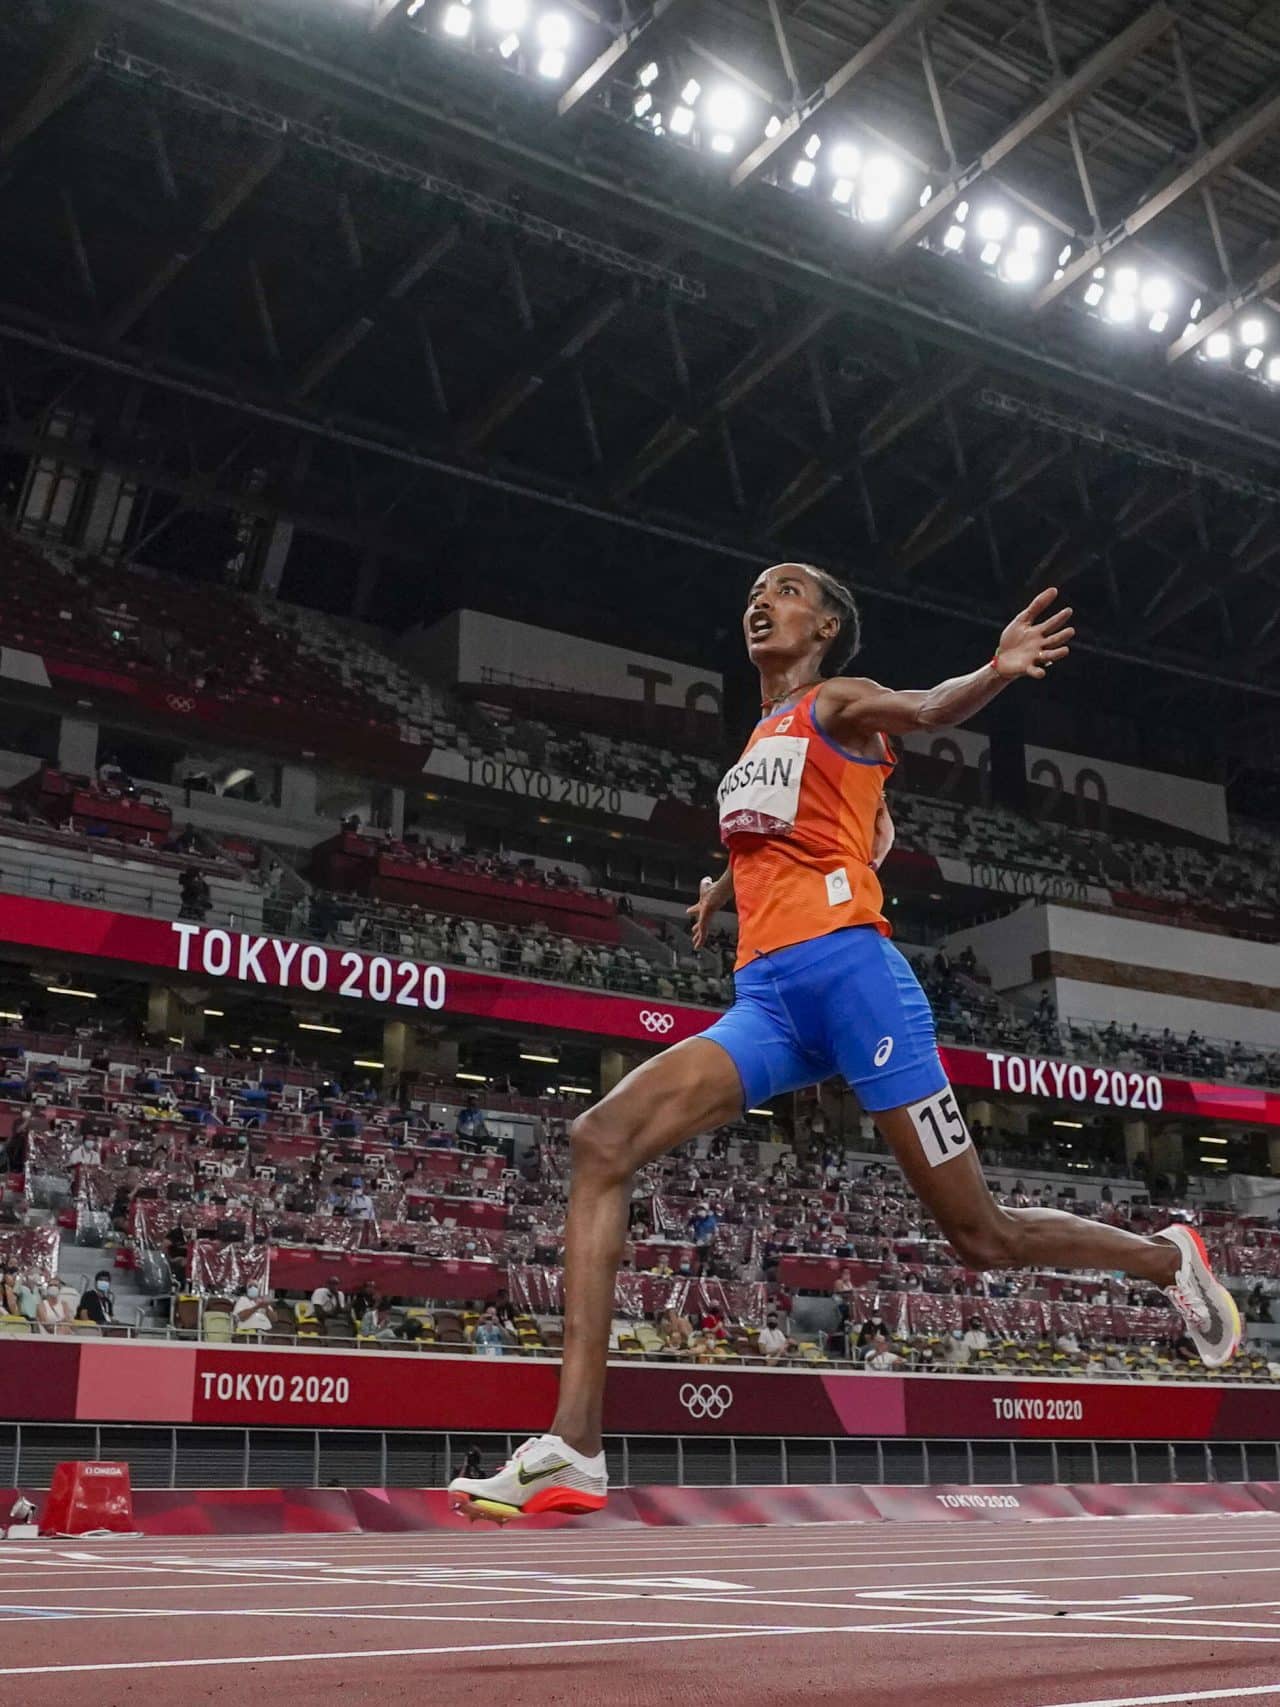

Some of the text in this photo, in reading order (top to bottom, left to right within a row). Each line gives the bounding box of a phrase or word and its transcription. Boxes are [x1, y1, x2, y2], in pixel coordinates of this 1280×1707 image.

[559, 777, 622, 814] 2020
[172, 922, 446, 1010] TOKYO 2020
[986, 1053, 1163, 1111] TOKYO 2020
[919, 1094, 966, 1154] 15
[201, 1372, 350, 1403] TOKYO 2020
[992, 1398, 1083, 1420] TOKYO 2020
[936, 1495, 1020, 1508] TOKYO 2020
